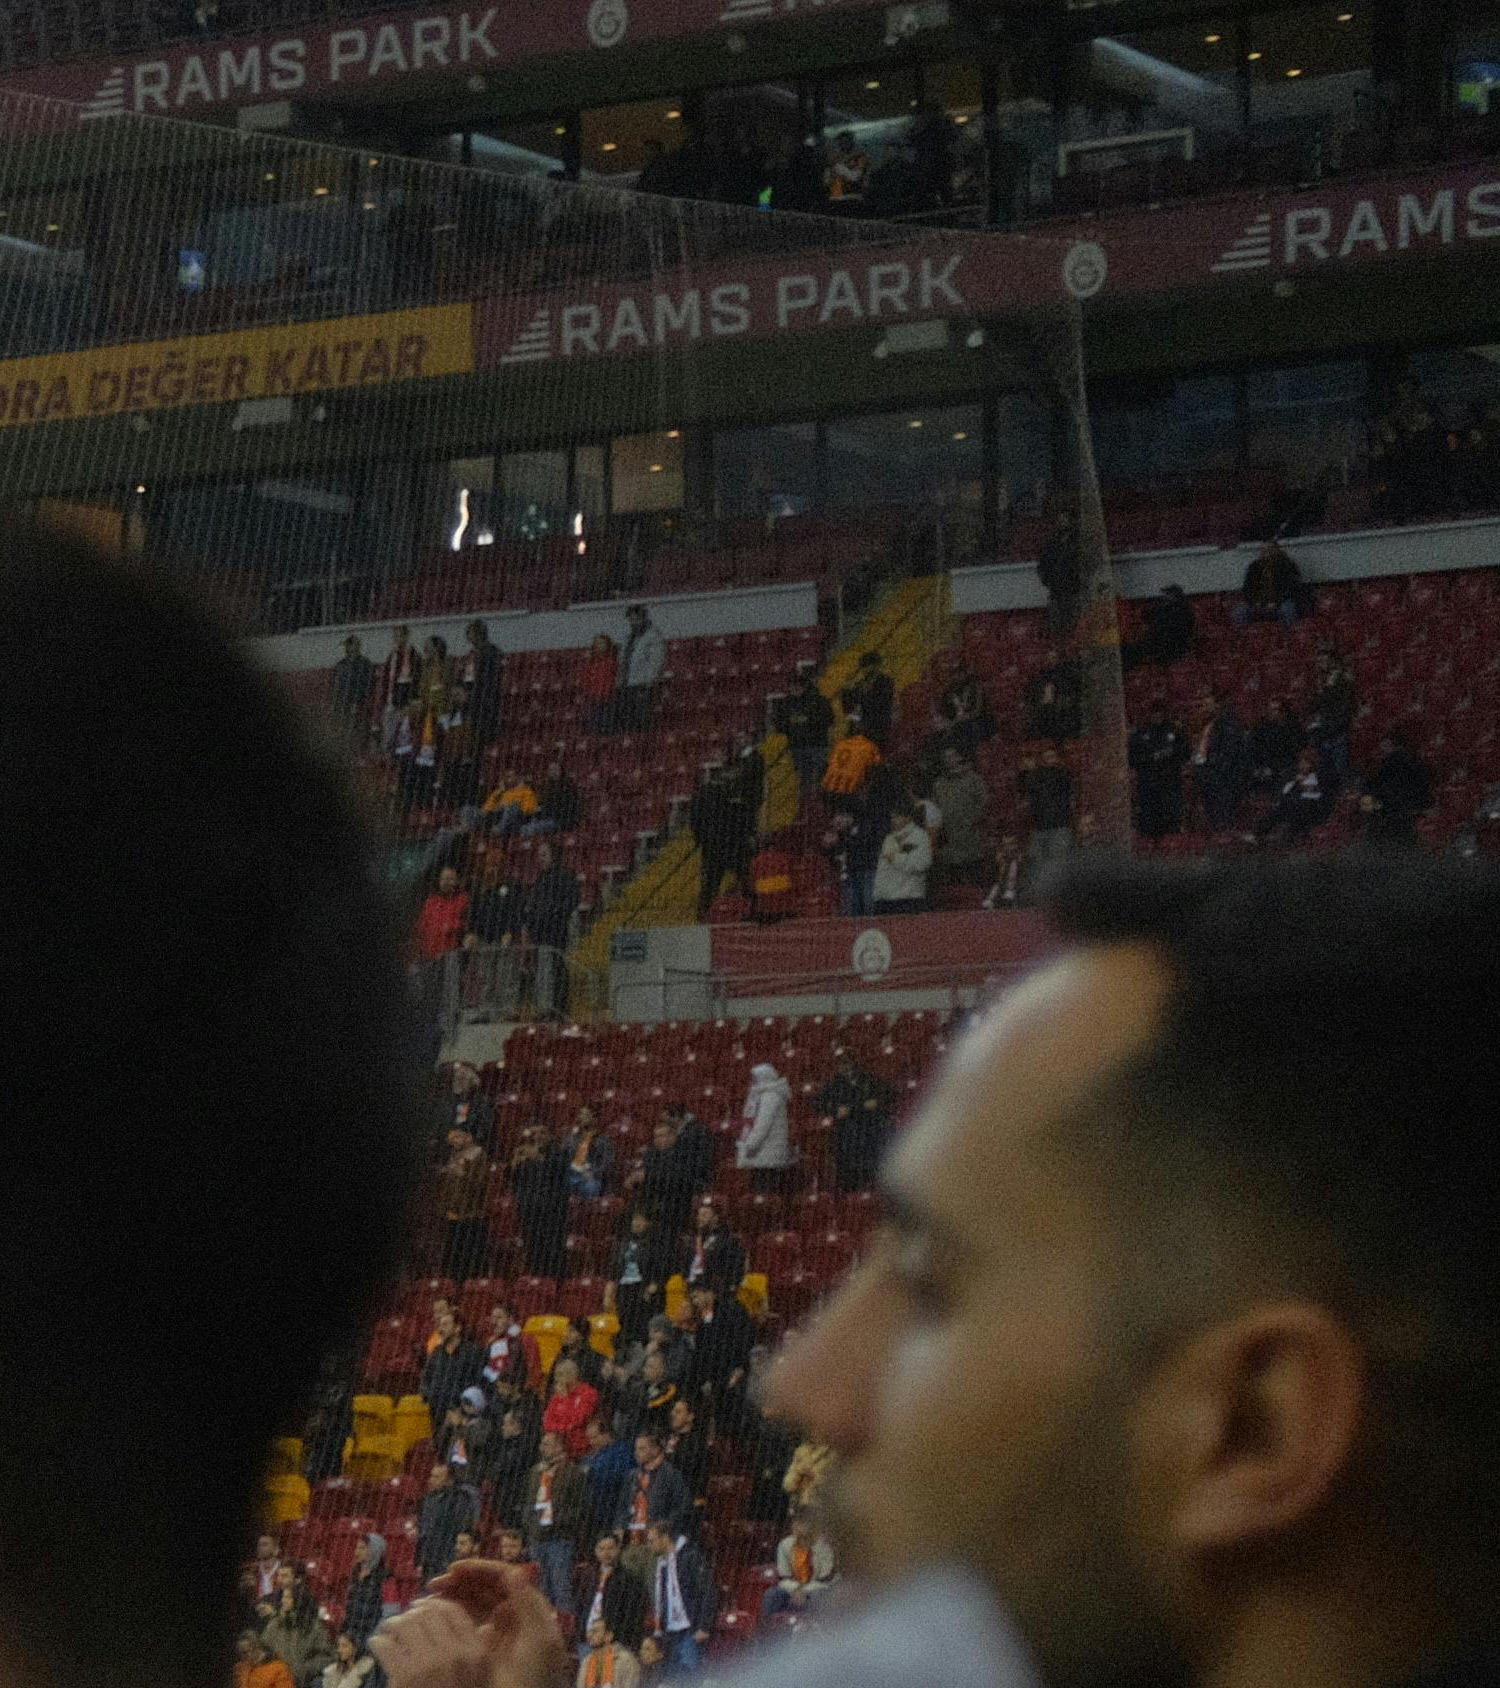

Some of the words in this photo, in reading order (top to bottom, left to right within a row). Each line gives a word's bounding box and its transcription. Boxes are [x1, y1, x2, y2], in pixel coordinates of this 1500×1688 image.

[133, 38, 308, 111] RAMS
[328, 9, 501, 82] PARK
[1282, 180, 1500, 266] RAMS
[562, 283, 750, 355] RAMS
[777, 257, 964, 329] PARK
[91, 353, 249, 412] DEĞER
[265, 335, 427, 394] KATAR
